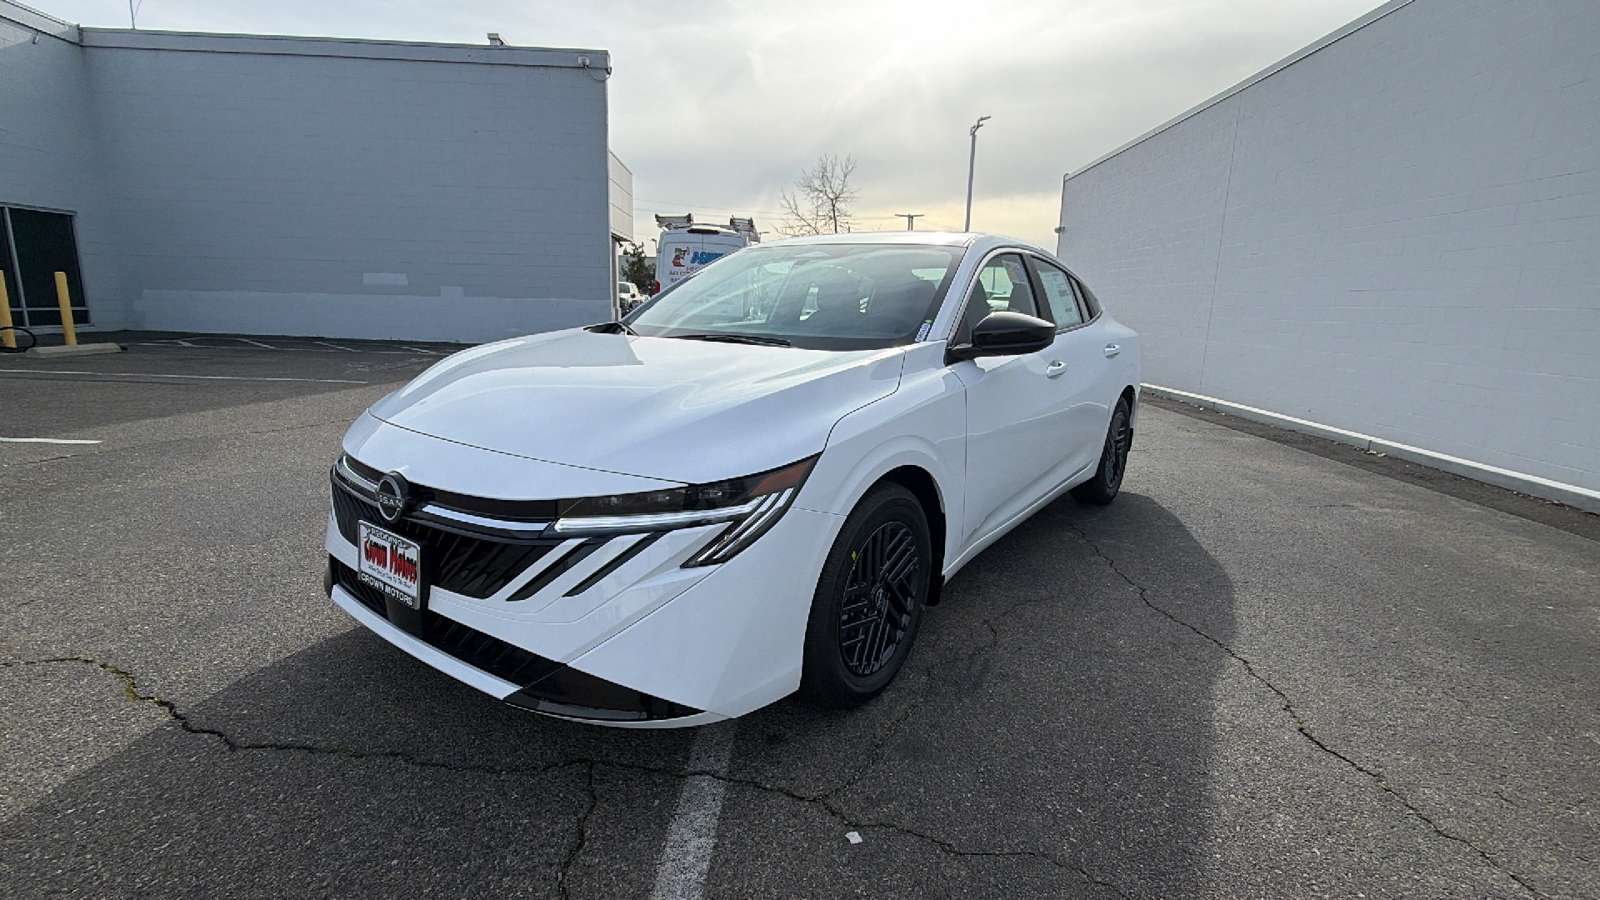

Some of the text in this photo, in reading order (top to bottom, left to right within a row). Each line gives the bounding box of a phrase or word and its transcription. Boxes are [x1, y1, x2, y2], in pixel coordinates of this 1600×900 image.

[371, 528, 403, 547] REDDING
[361, 573, 413, 606] CROWN MOTORS
